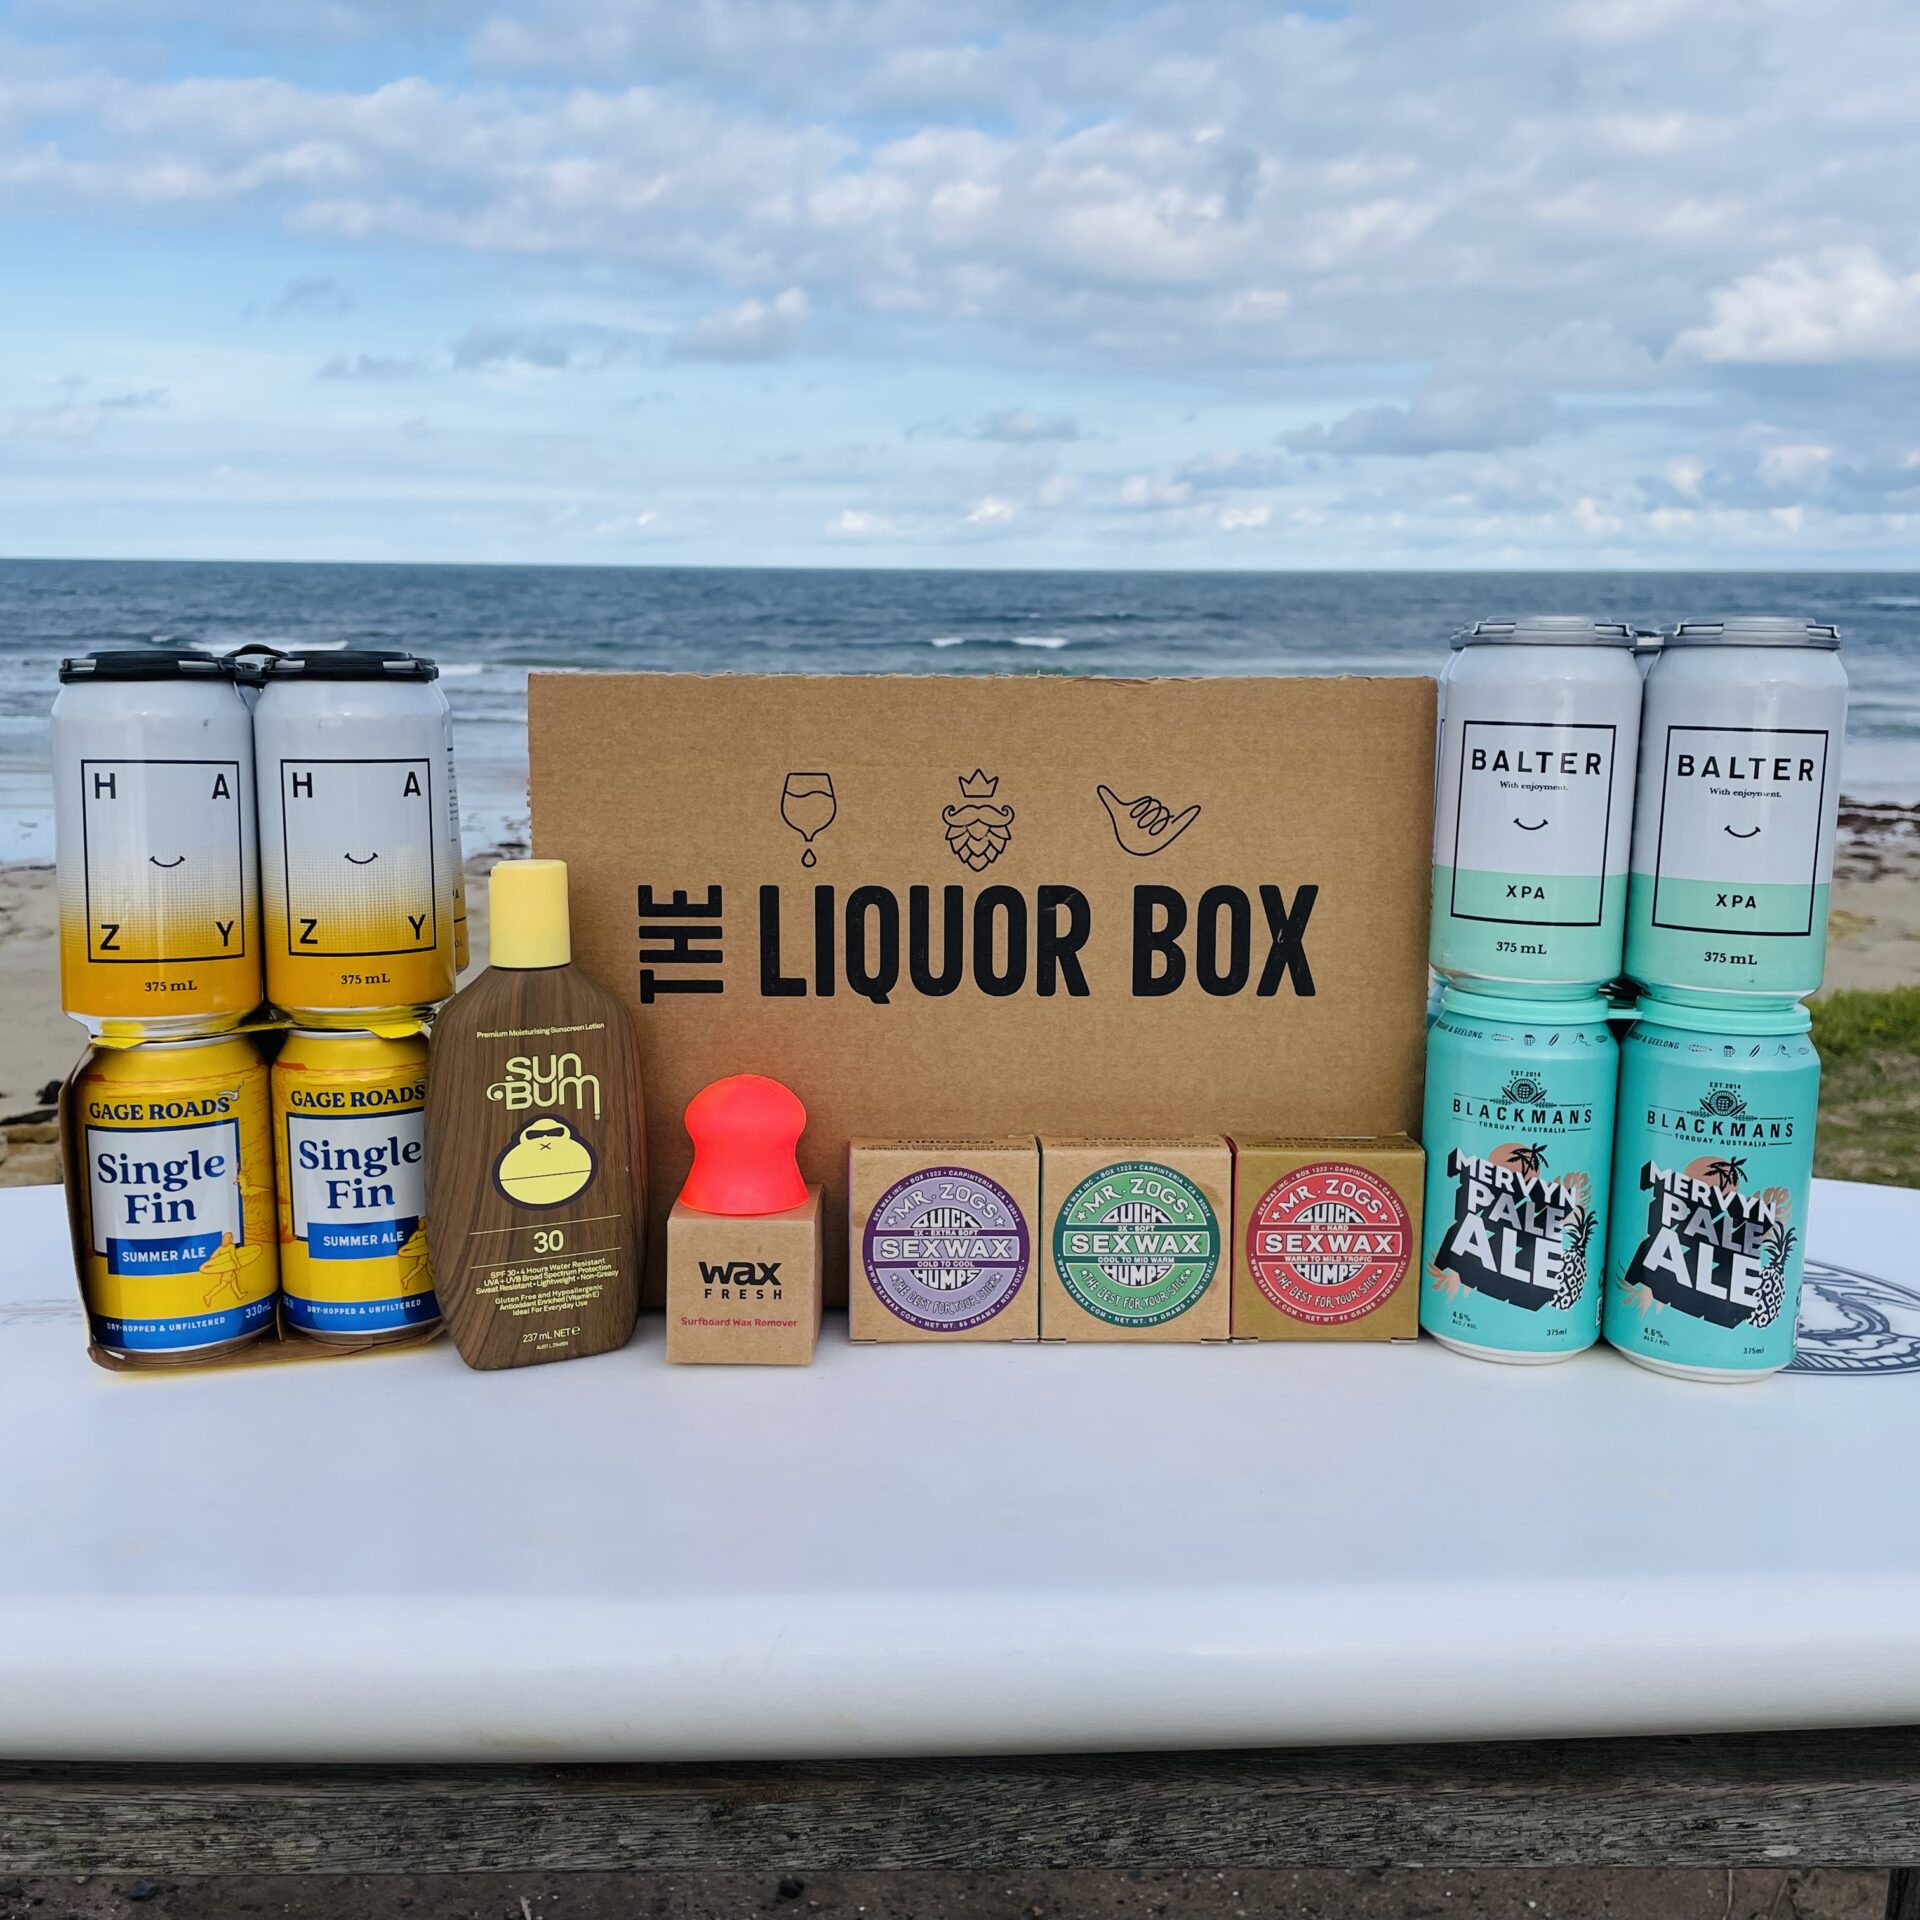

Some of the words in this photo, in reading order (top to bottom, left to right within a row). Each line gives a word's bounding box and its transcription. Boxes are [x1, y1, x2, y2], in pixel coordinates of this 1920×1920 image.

[1471, 749, 1601, 775] BALTER
[1678, 755, 1814, 781] BALTER
[95, 773, 116, 799] H
[212, 774, 230, 799] A
[293, 772, 313, 798] H
[403, 772, 421, 797] A
[1500, 781, 1518, 789] With
[1710, 787, 1730, 796] With
[1506, 885, 1545, 899] XPA
[1716, 894, 1756, 908] XPA
[101, 925, 120, 950] Z
[216, 921, 234, 946] Y
[300, 919, 318, 944] Z
[408, 914, 426, 940] Y
[638, 885, 724, 1004] THE
[759, 885, 1091, 1004] LIQUOR
[1132, 885, 1319, 997] BOX
[1496, 941, 1518, 953] 375
[1521, 943, 1547, 955] mL
[1704, 952, 1726, 964] 375
[1730, 954, 1757, 965] mL
[144, 981, 167, 992] 375
[170, 980, 197, 991] mL
[341, 975, 361, 985] 375
[365, 973, 390, 984] mL
[476, 1031, 508, 1039] Premium
[509, 1028, 550, 1037] Moisturising
[550, 1025, 584, 1034] Sunscreen
[1454, 1027, 1483, 1039] GEELONG
[1648, 1037, 1680, 1049] GEELONG
[290, 1090, 345, 1108] GAGE
[350, 1084, 425, 1107] ROADS
[89, 1102, 143, 1120] GAGE
[149, 1097, 230, 1120] ROADS
[1453, 1099, 1592, 1124] BLACKMANS
[1647, 1110, 1793, 1138] BLACKMANS
[299, 1136, 422, 1178] Single
[97, 1150, 226, 1192] Single
[1455, 1147, 1577, 1209] MERVYN
[325, 1178, 395, 1210] Fin
[938, 1182, 999, 1219] ZOGS
[1129, 1177, 1189, 1214] ZOGS
[1325, 1178, 1383, 1214] ZOGS
[1649, 1160, 1776, 1225] MERVYN
[125, 1193, 197, 1224] Fin
[910, 1207, 981, 1228] QUICK
[1100, 1203, 1171, 1223] QUICK
[1295, 1203, 1365, 1223] QUICK
[1467, 1178, 1565, 1241] PALE
[1662, 1192, 1764, 1258] PALE
[323, 1233, 378, 1247] SUMMER
[381, 1231, 404, 1244] ALE
[533, 1230, 564, 1253] 30
[881, 1238, 1012, 1259] SEXWAX
[1071, 1234, 1201, 1254] SEXWAX
[1264, 1233, 1394, 1253] SEXWAX
[122, 1251, 178, 1263] SUMMER
[181, 1247, 206, 1261] ALE
[1450, 1212, 1565, 1291] ALE
[484, 1279, 499, 1287] UVA
[522, 1273, 543, 1282] Broad
[544, 1269, 577, 1280] Spectrum
[578, 1264, 611, 1275] Protection
[490, 1271, 506, 1279] SPF
[527, 1266, 548, 1274] Hours
[550, 1263, 570, 1272] Water
[572, 1258, 605, 1268] Resistant
[698, 1261, 782, 1286] wax
[1103, 1264, 1170, 1285] HUMPS
[1295, 1263, 1364, 1284] HUMPS
[1642, 1226, 1763, 1308] ALE
[476, 1286, 499, 1294] Sweat
[500, 1282, 533, 1291] Resistant
[537, 1276, 576, 1288] Lightweight
[580, 1270, 619, 1280] Non-Greasy
[913, 1268, 980, 1290] HUMPS
[1275, 1270, 1292, 1290] THE
[1289, 1287, 1312, 1304] BEST
[1315, 1296, 1335, 1309] FOR
[1336, 1291, 1360, 1306] YOUR
[1358, 1273, 1381, 1294] STICK
[495, 1296, 519, 1305] Gluten
[520, 1294, 537, 1302] Free
[538, 1291, 552, 1299] and
[552, 1285, 603, 1298] Hypoallergenic
[704, 1288, 782, 1300] FRESH
[892, 1275, 908, 1296] THE
[906, 1292, 931, 1311] BEST
[932, 1301, 955, 1315] FOR
[954, 1296, 979, 1313] YOUR
[1082, 1270, 1099, 1291] THE
[1097, 1287, 1121, 1306] BEST
[1123, 1297, 1144, 1310] FOR
[1144, 1291, 1169, 1307] YOUR
[1168, 1274, 1190, 1295] STICK
[245, 1304, 271, 1319] 330mL
[307, 1305, 356, 1315] DRY-HOPPED
[369, 1299, 421, 1314] UNFILTERED
[513, 1308, 530, 1316] Ideal
[543, 1302, 575, 1312] Everyday
[1452, 1311, 1471, 1321] 4.6%
[169, 1317, 226, 1331] UNFILTERED
[681, 1317, 731, 1326] Surfboard
[733, 1318, 752, 1326] Wax
[755, 1318, 798, 1327] Remover
[1644, 1327, 1663, 1338] 4.6%
[522, 1333, 538, 1343] 237
[539, 1331, 552, 1340] mL
[553, 1328, 571, 1338] NET
